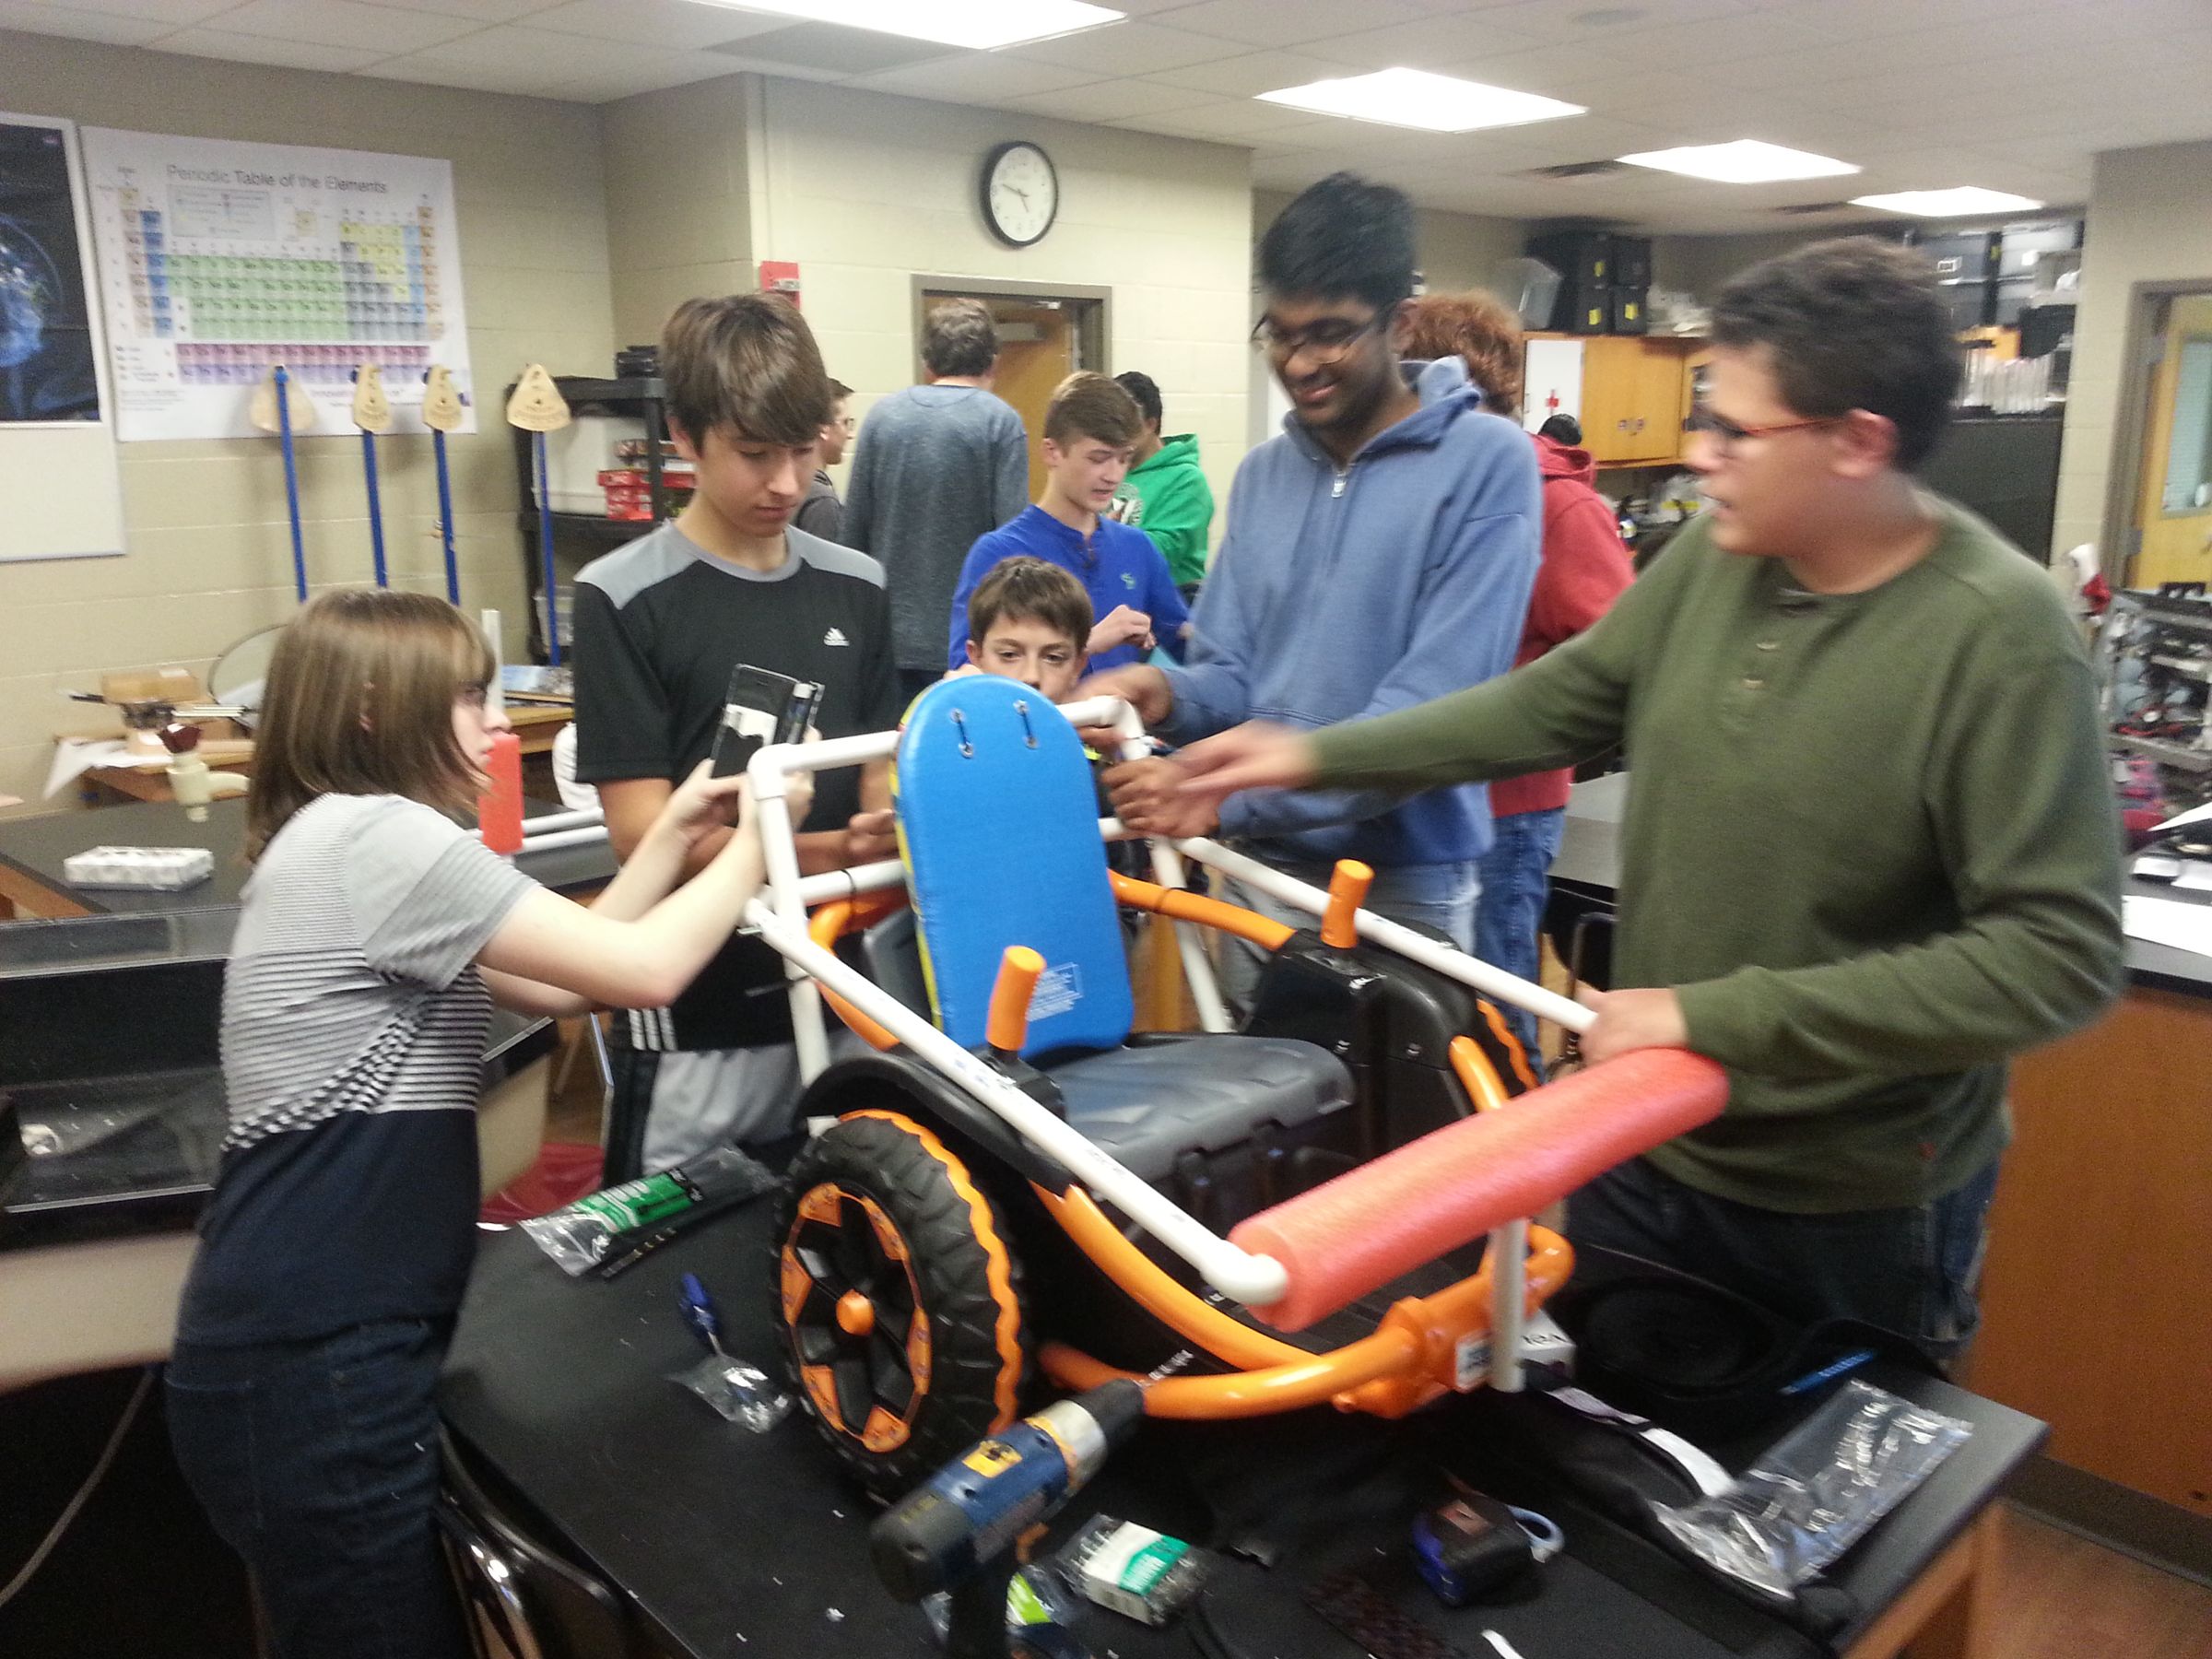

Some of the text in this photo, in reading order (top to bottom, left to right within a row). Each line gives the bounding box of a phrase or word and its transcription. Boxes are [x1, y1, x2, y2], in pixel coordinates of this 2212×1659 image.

[166, 164, 387, 194] Periodic Table of the Elements
